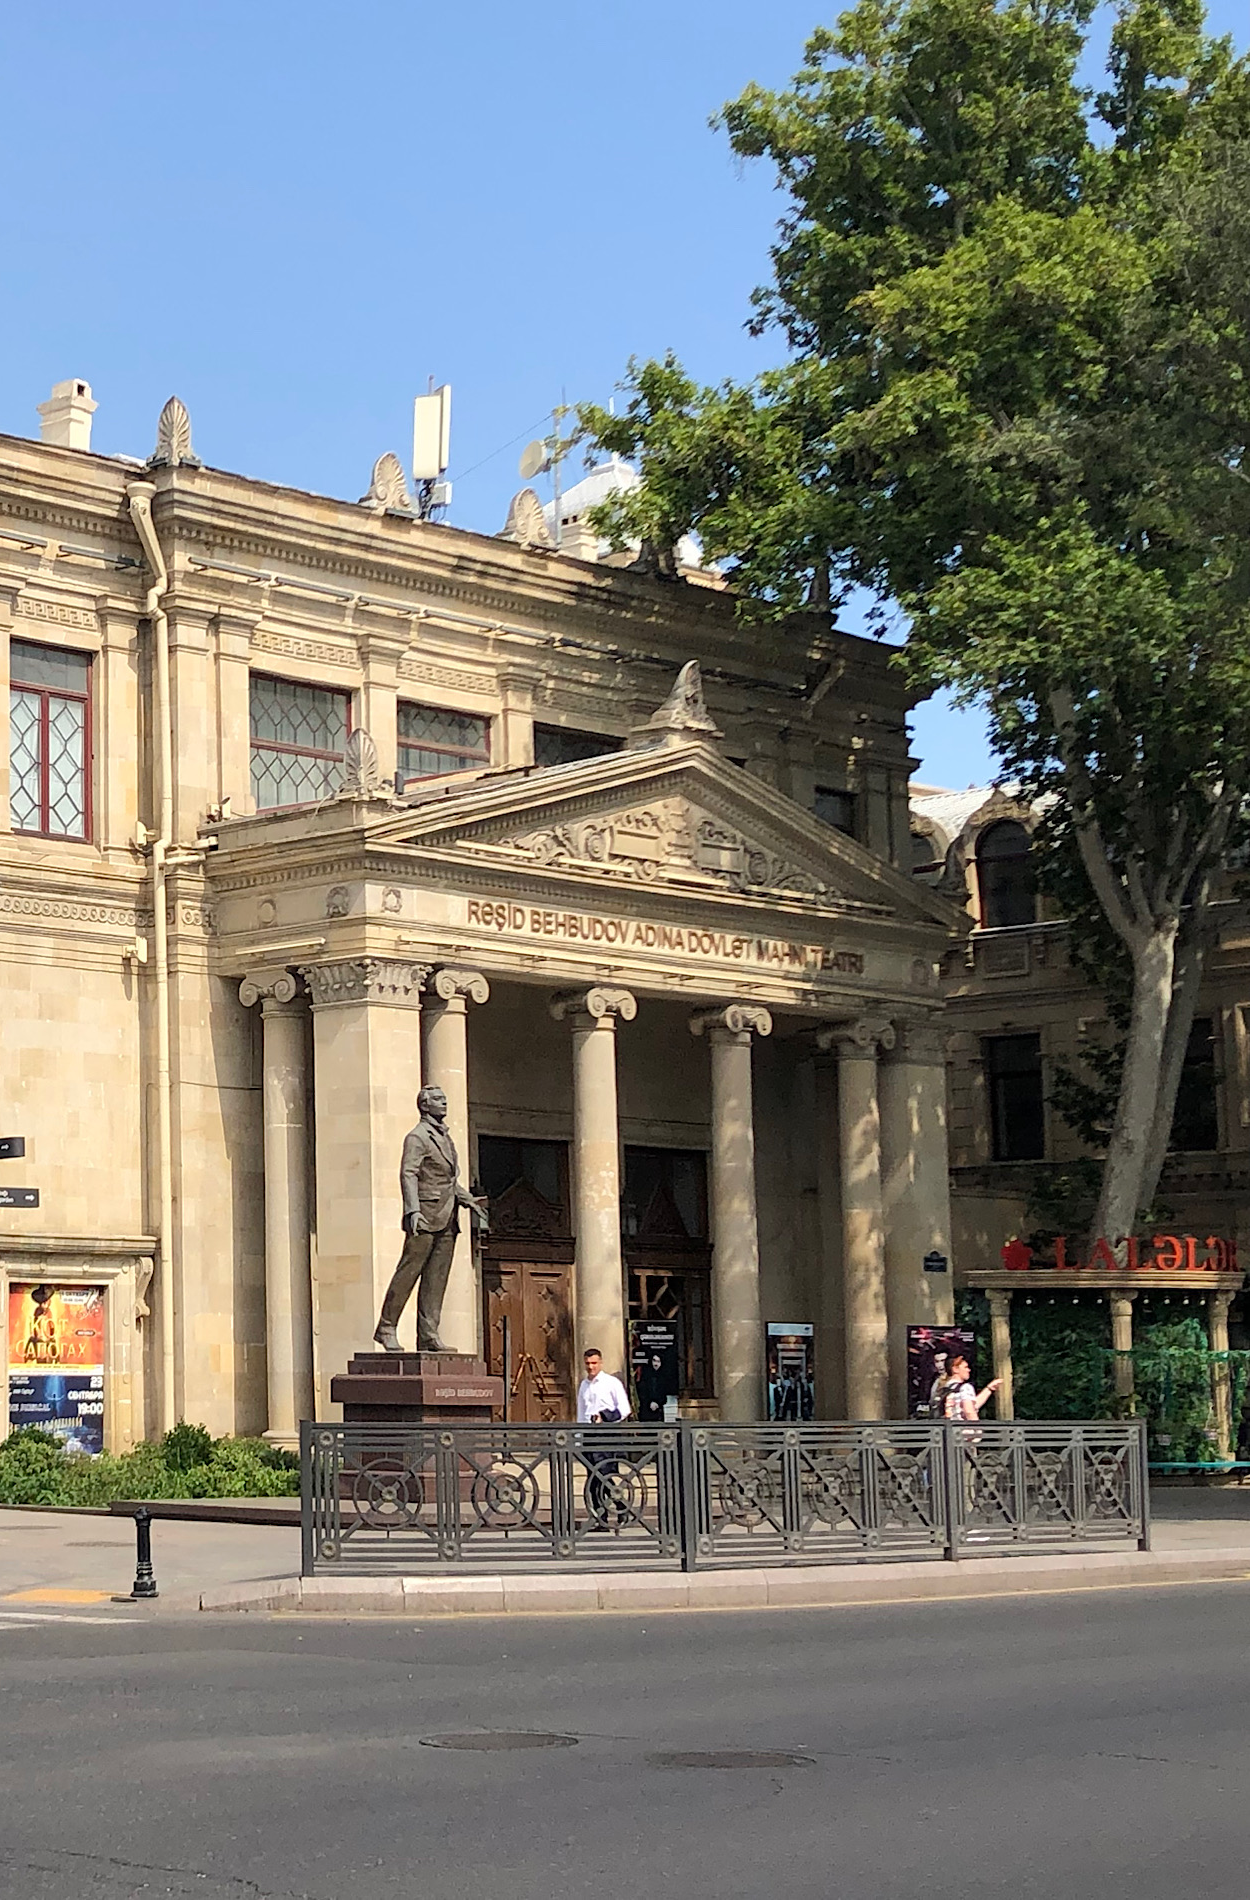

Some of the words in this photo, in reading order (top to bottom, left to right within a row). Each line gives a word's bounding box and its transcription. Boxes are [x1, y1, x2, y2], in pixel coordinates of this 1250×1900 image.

[468, 900, 526, 931] RƏŞİD
[530, 909, 629, 944] BEHBUDOV
[631, 922, 685, 950] ADINA
[15, 1340, 87, 1359] САПОГАХ
[90, 1376, 104, 1388] 23
